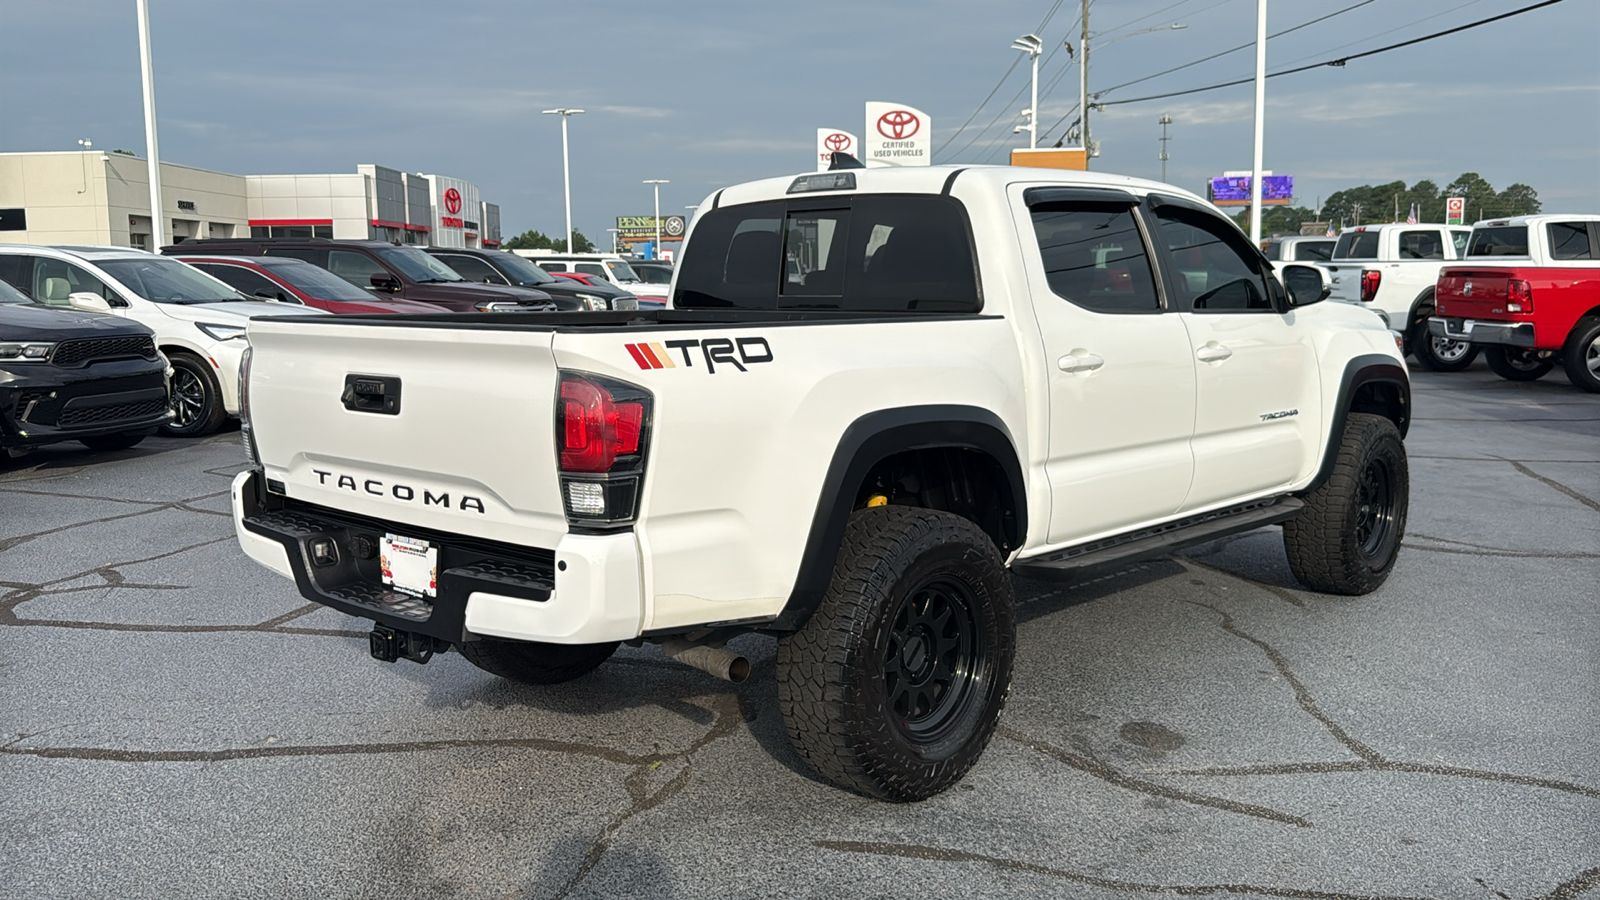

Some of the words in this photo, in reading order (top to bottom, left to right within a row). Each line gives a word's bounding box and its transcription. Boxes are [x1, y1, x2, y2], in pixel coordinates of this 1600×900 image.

[882, 141, 915, 149] CERTIFIED
[873, 150, 892, 158] USED
[892, 149, 923, 157] VEHICLES
[664, 336, 774, 374] TRD
[1259, 409, 1299, 421] TACOMA
[312, 469, 485, 514] TACOMA
